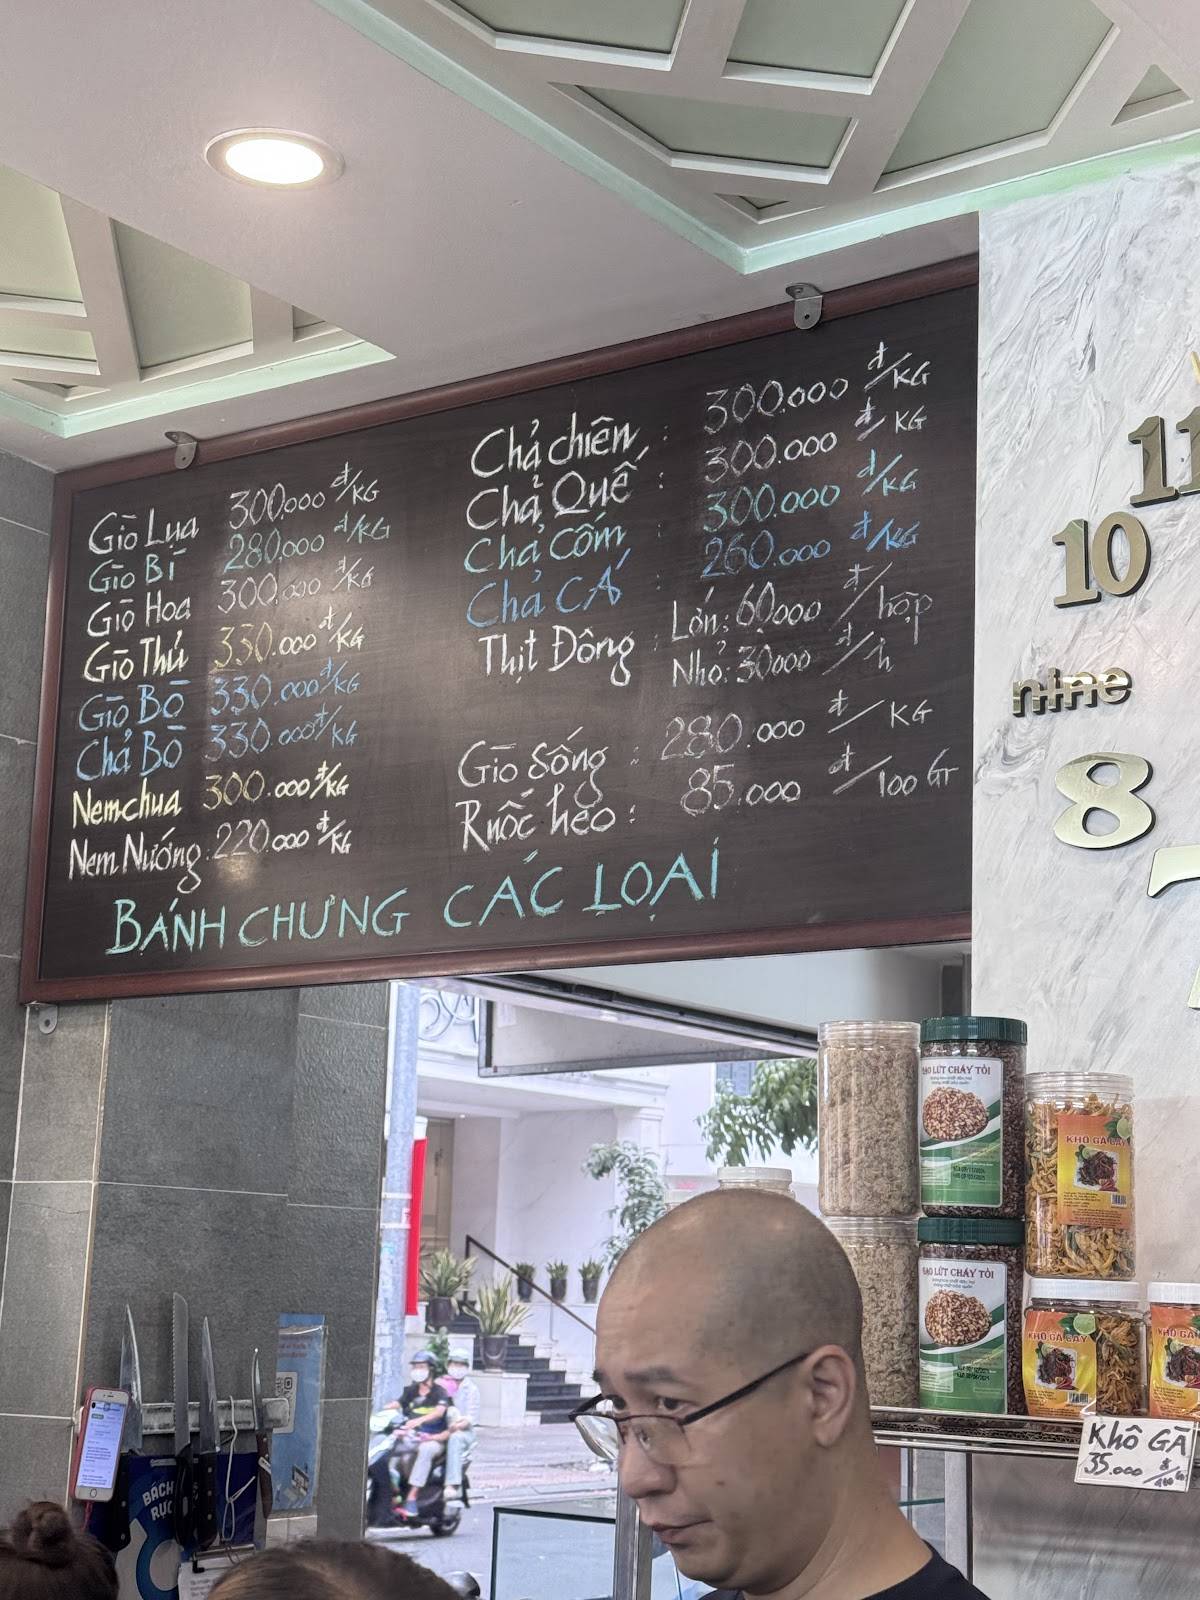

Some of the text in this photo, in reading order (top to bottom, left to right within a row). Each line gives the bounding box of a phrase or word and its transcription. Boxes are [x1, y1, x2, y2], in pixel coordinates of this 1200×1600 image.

[471, 418, 542, 478] Chả
[703, 378, 849, 434] 300.000
[466, 474, 544, 530] Chả
[704, 432, 838, 484] 300.000
[143, 507, 200, 549] Lụa
[229, 482, 326, 530] 300.000
[464, 523, 547, 574] Chả
[703, 483, 841, 532] 300.000
[223, 528, 325, 573] 280.000
[466, 570, 546, 628] Chả
[700, 530, 832, 578] 260.000
[1051, 511, 1151, 609] 10
[145, 588, 193, 627] Hoa
[217, 572, 321, 614] 300.000
[478, 628, 538, 684] Thịt
[548, 623, 635, 687] Đông
[210, 673, 321, 716] 330.000
[1012, 666, 1133, 718] nine
[75, 727, 134, 782] Chả
[660, 712, 806, 761] 280.000
[202, 769, 312, 810] 300.000
[679, 763, 802, 816] 85.000
[1053, 751, 1157, 851] 8
[68, 838, 120, 881] Nem
[121, 826, 203, 895] Nướng
[103, 897, 226, 954] BÁNH
[238, 887, 409, 948] CHƯNG
[443, 848, 564, 928] CÁC
[1083, 1451, 1143, 1476] 35.000
[1088, 1420, 1143, 1450] Khô
